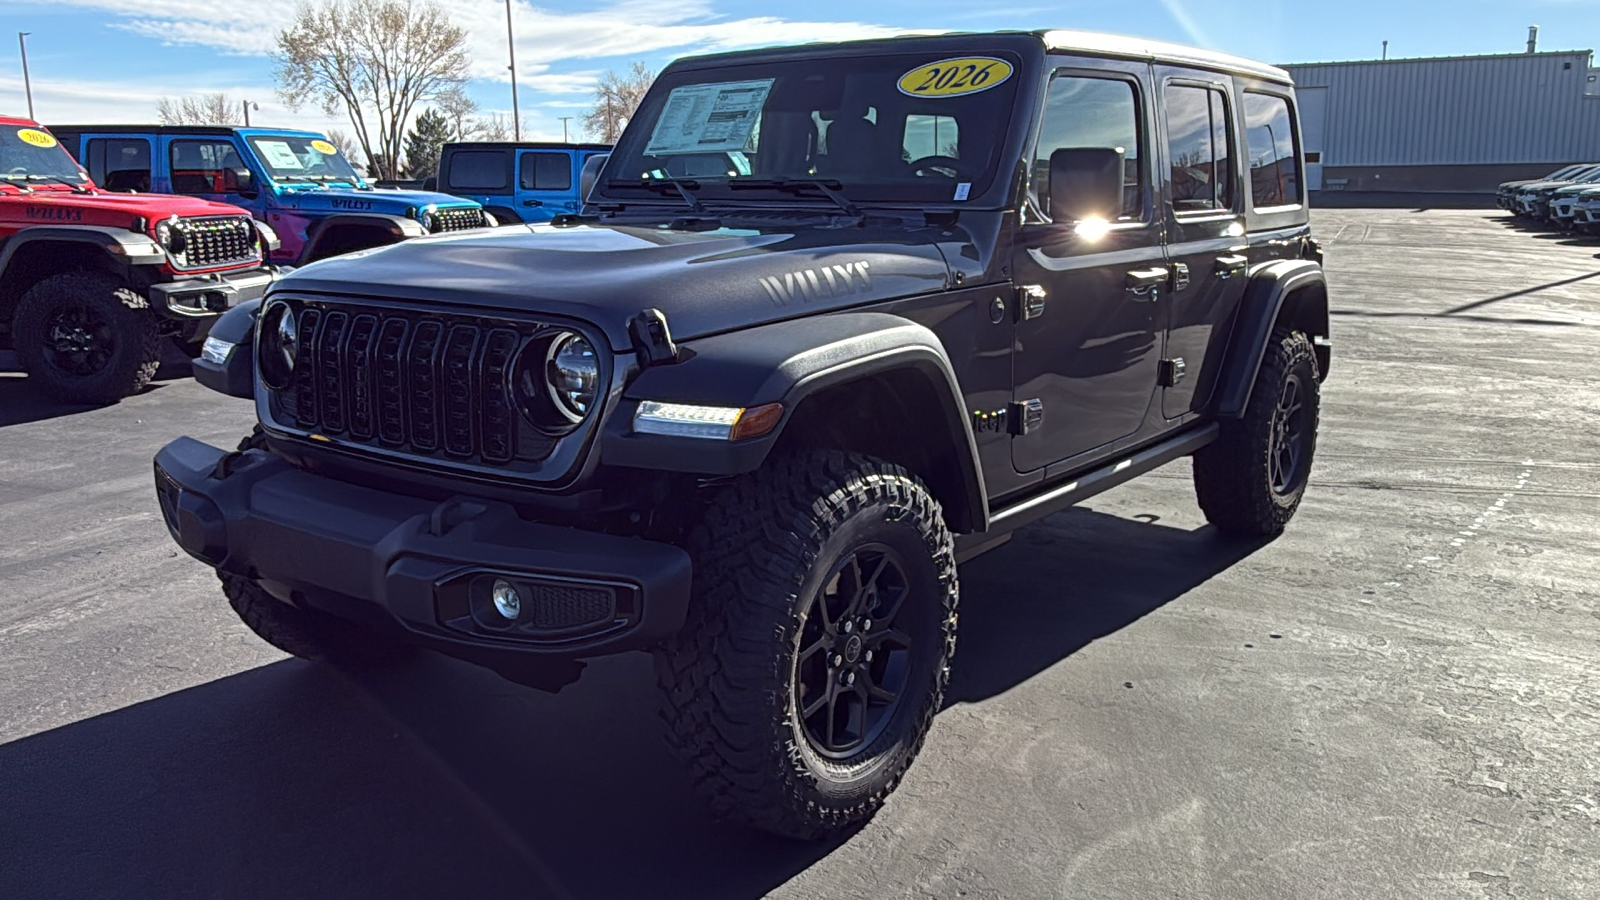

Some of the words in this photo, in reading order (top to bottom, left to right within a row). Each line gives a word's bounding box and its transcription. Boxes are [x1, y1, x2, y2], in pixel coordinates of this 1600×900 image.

[913, 62, 999, 92] 2026
[26, 132, 50, 144] 2026
[331, 199, 374, 210] WILLYS
[759, 260, 873, 307] WILLYS
